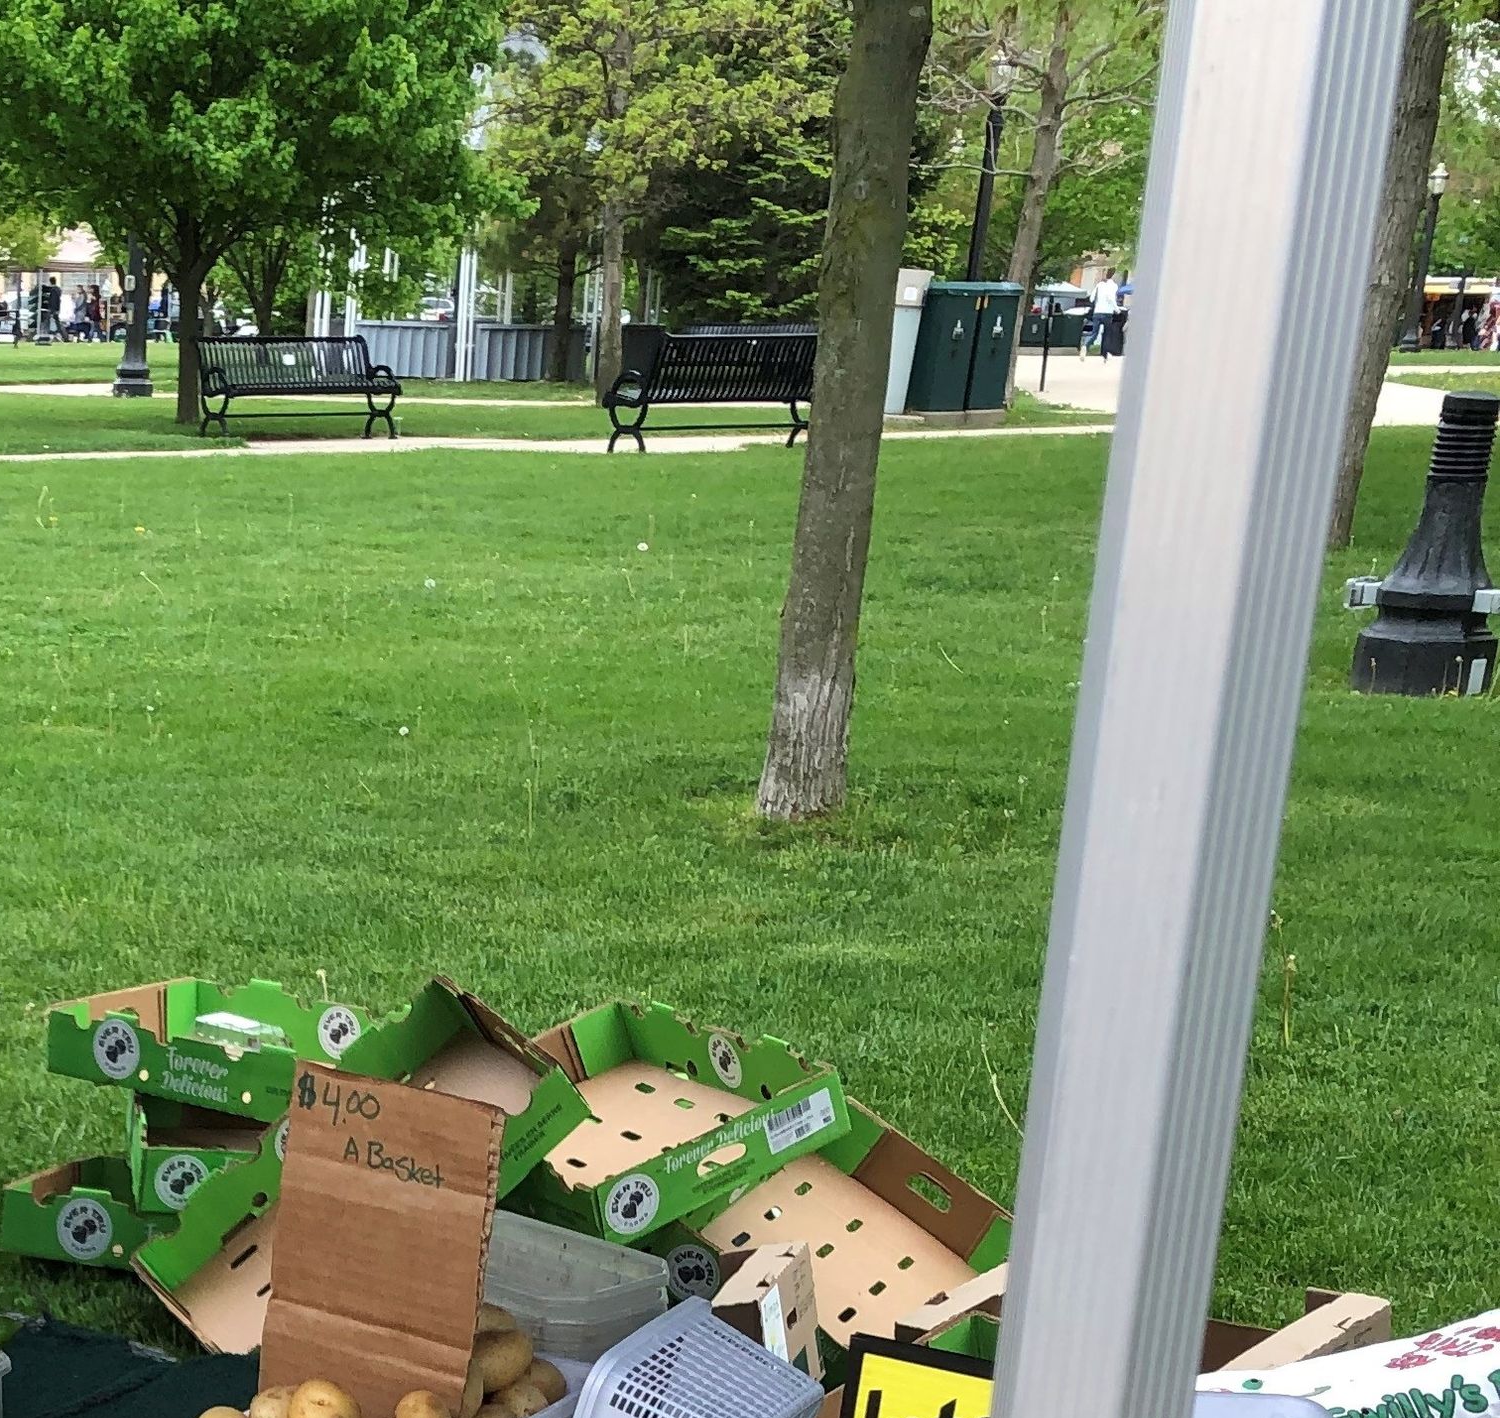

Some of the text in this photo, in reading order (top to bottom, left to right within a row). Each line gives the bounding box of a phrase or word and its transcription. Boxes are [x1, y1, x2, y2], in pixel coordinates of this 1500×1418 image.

[343, 1136, 359, 1164] A
[611, 1180, 653, 1215] EVER TRU
[674, 1250, 715, 1288] EVER TRU
